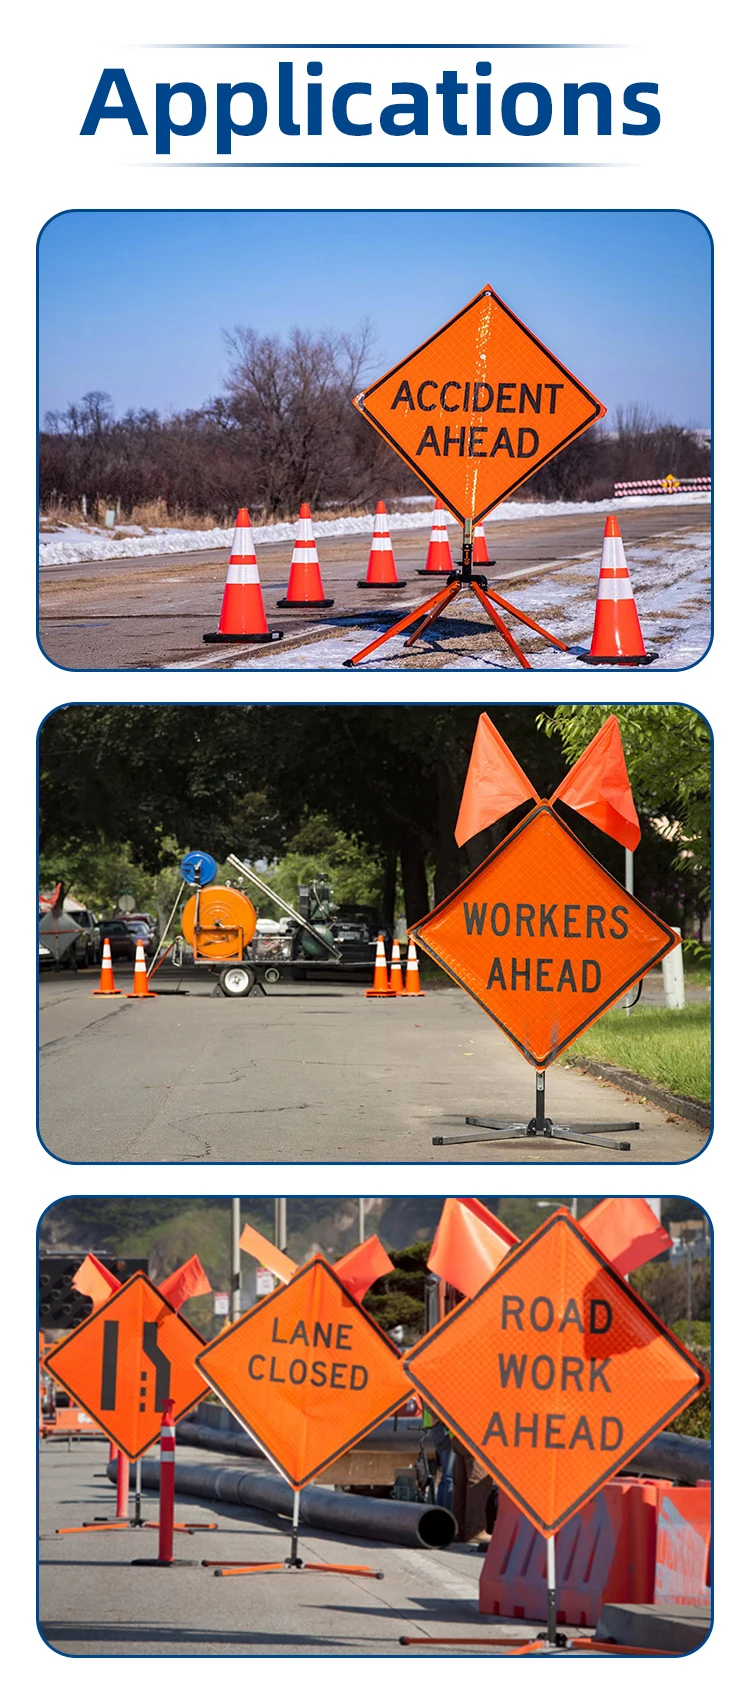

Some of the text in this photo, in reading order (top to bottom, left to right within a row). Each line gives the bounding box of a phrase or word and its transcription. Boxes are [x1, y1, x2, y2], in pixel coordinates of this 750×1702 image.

[390, 381, 564, 414] ACCIDENT
[415, 426, 540, 459] AHEAD
[463, 902, 629, 940] WORKERS
[486, 957, 602, 993] AHEAD
[272, 1318, 353, 1351] LANE
[501, 1296, 613, 1336] ROAD
[248, 1354, 369, 1392] CLOSED
[498, 1354, 612, 1393] WORK
[482, 1412, 624, 1452] AHEAD
